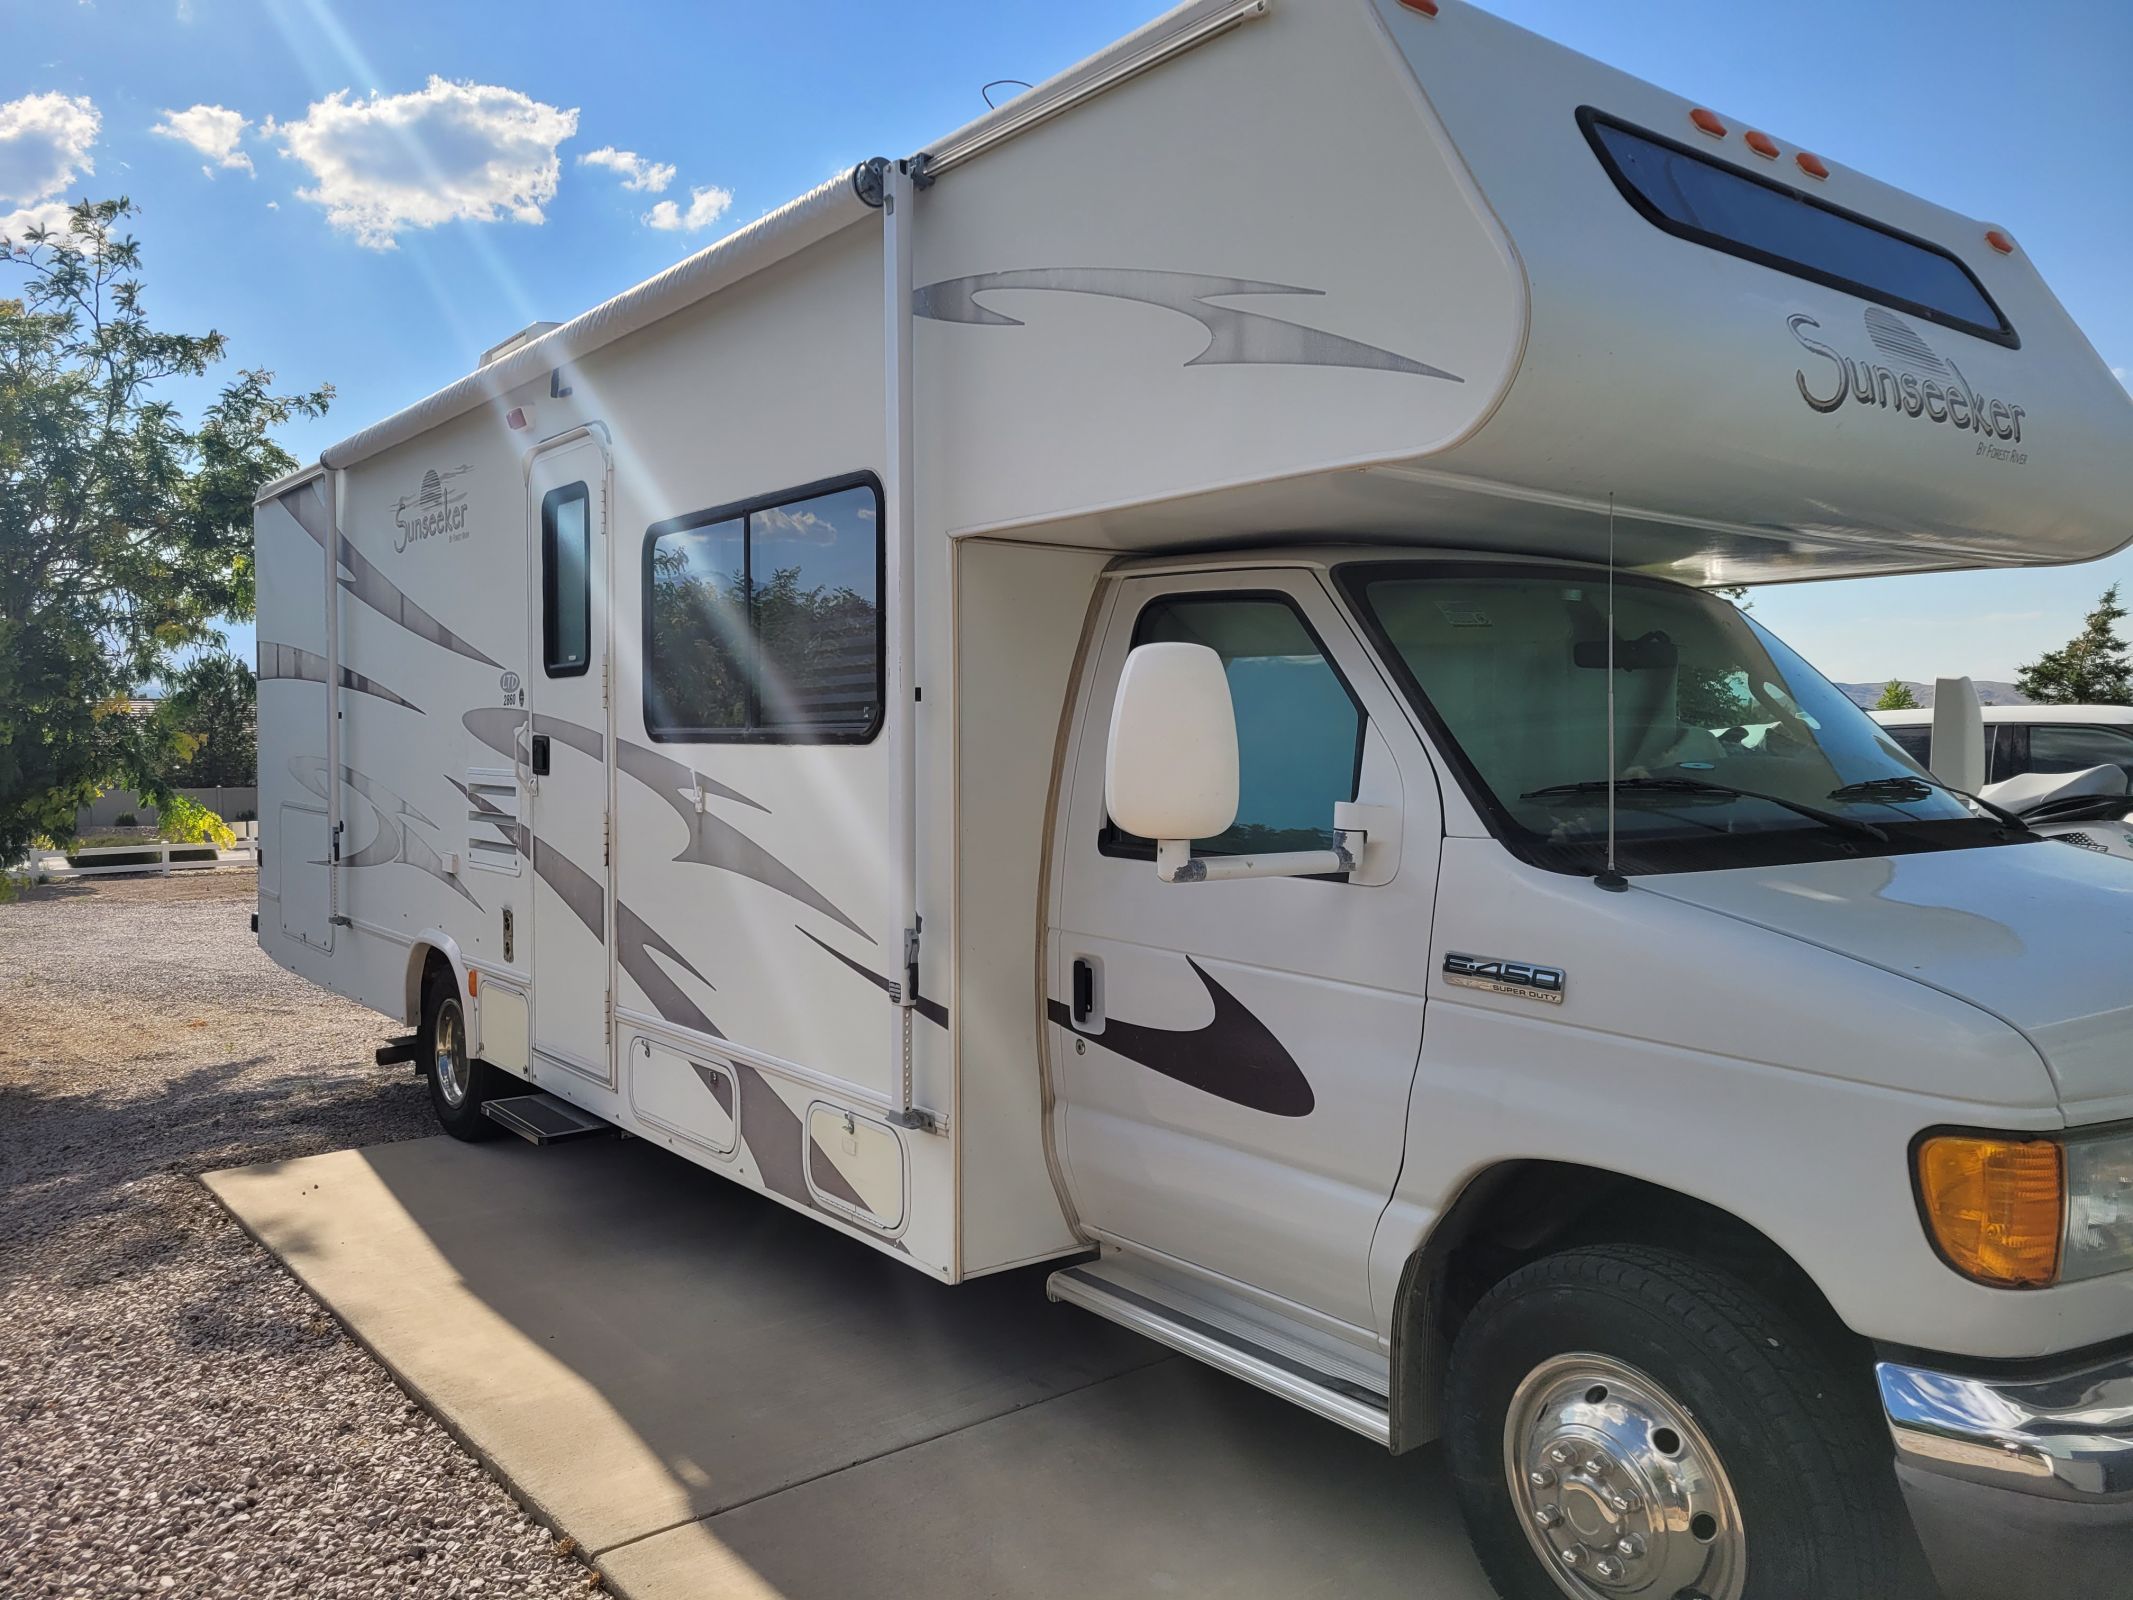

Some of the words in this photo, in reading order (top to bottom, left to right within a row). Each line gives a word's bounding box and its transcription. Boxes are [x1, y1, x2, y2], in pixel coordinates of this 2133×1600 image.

[1786, 313, 2026, 443] Sunseeker
[393, 487, 468, 554] Sunseeker
[1442, 954, 1561, 991] E-450
[1492, 984, 1526, 996] SUPER
[1528, 991, 1558, 1001] DUTY
